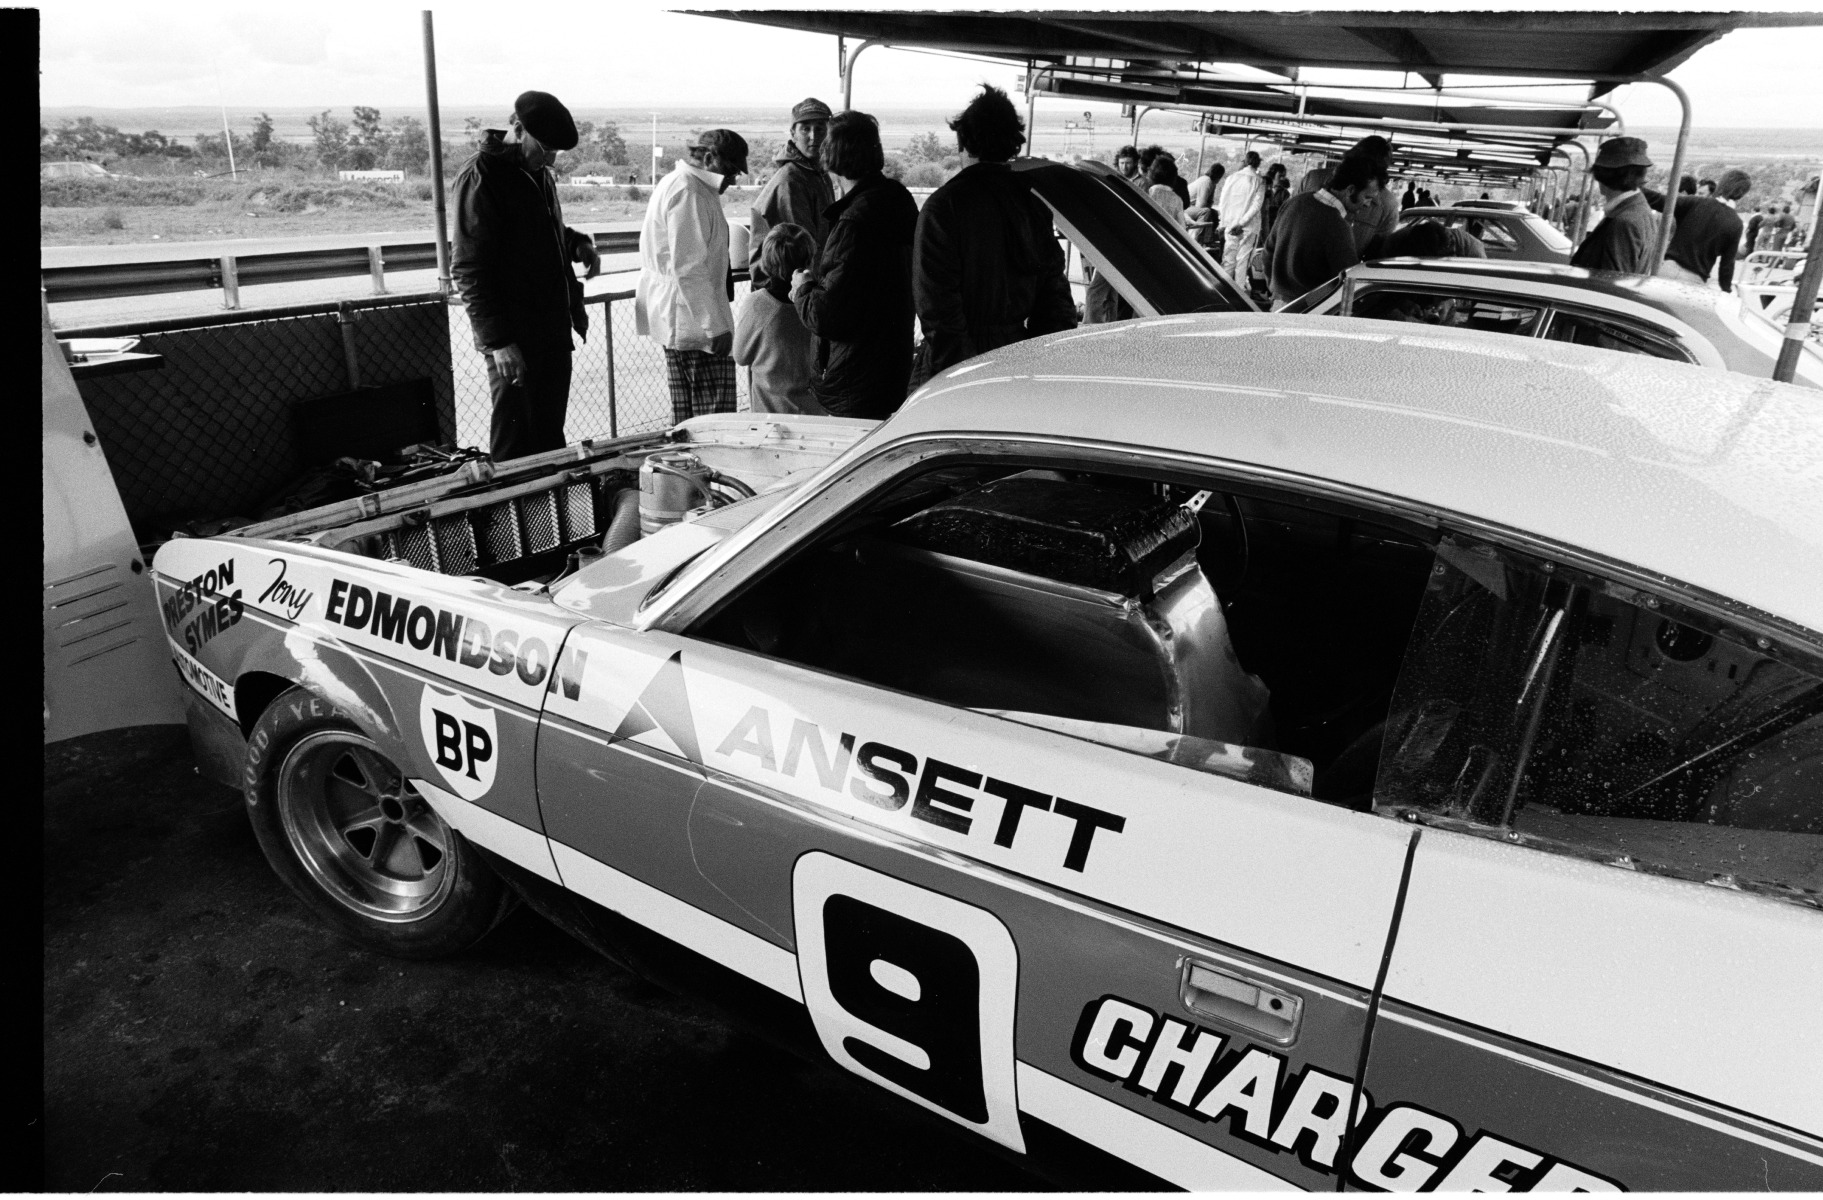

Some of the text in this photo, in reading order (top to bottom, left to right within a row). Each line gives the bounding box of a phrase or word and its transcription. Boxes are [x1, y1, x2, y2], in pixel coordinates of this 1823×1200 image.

[1193, 120, 1201, 131] K
[162, 558, 234, 634] PRESTON
[185, 589, 244, 657] SYMES
[258, 558, 314, 620] Tony
[324, 578, 589, 702] EDMONDSON
[431, 707, 493, 782] BP
[715, 705, 1127, 873] ANSETT
[823, 893, 990, 1125] 9
